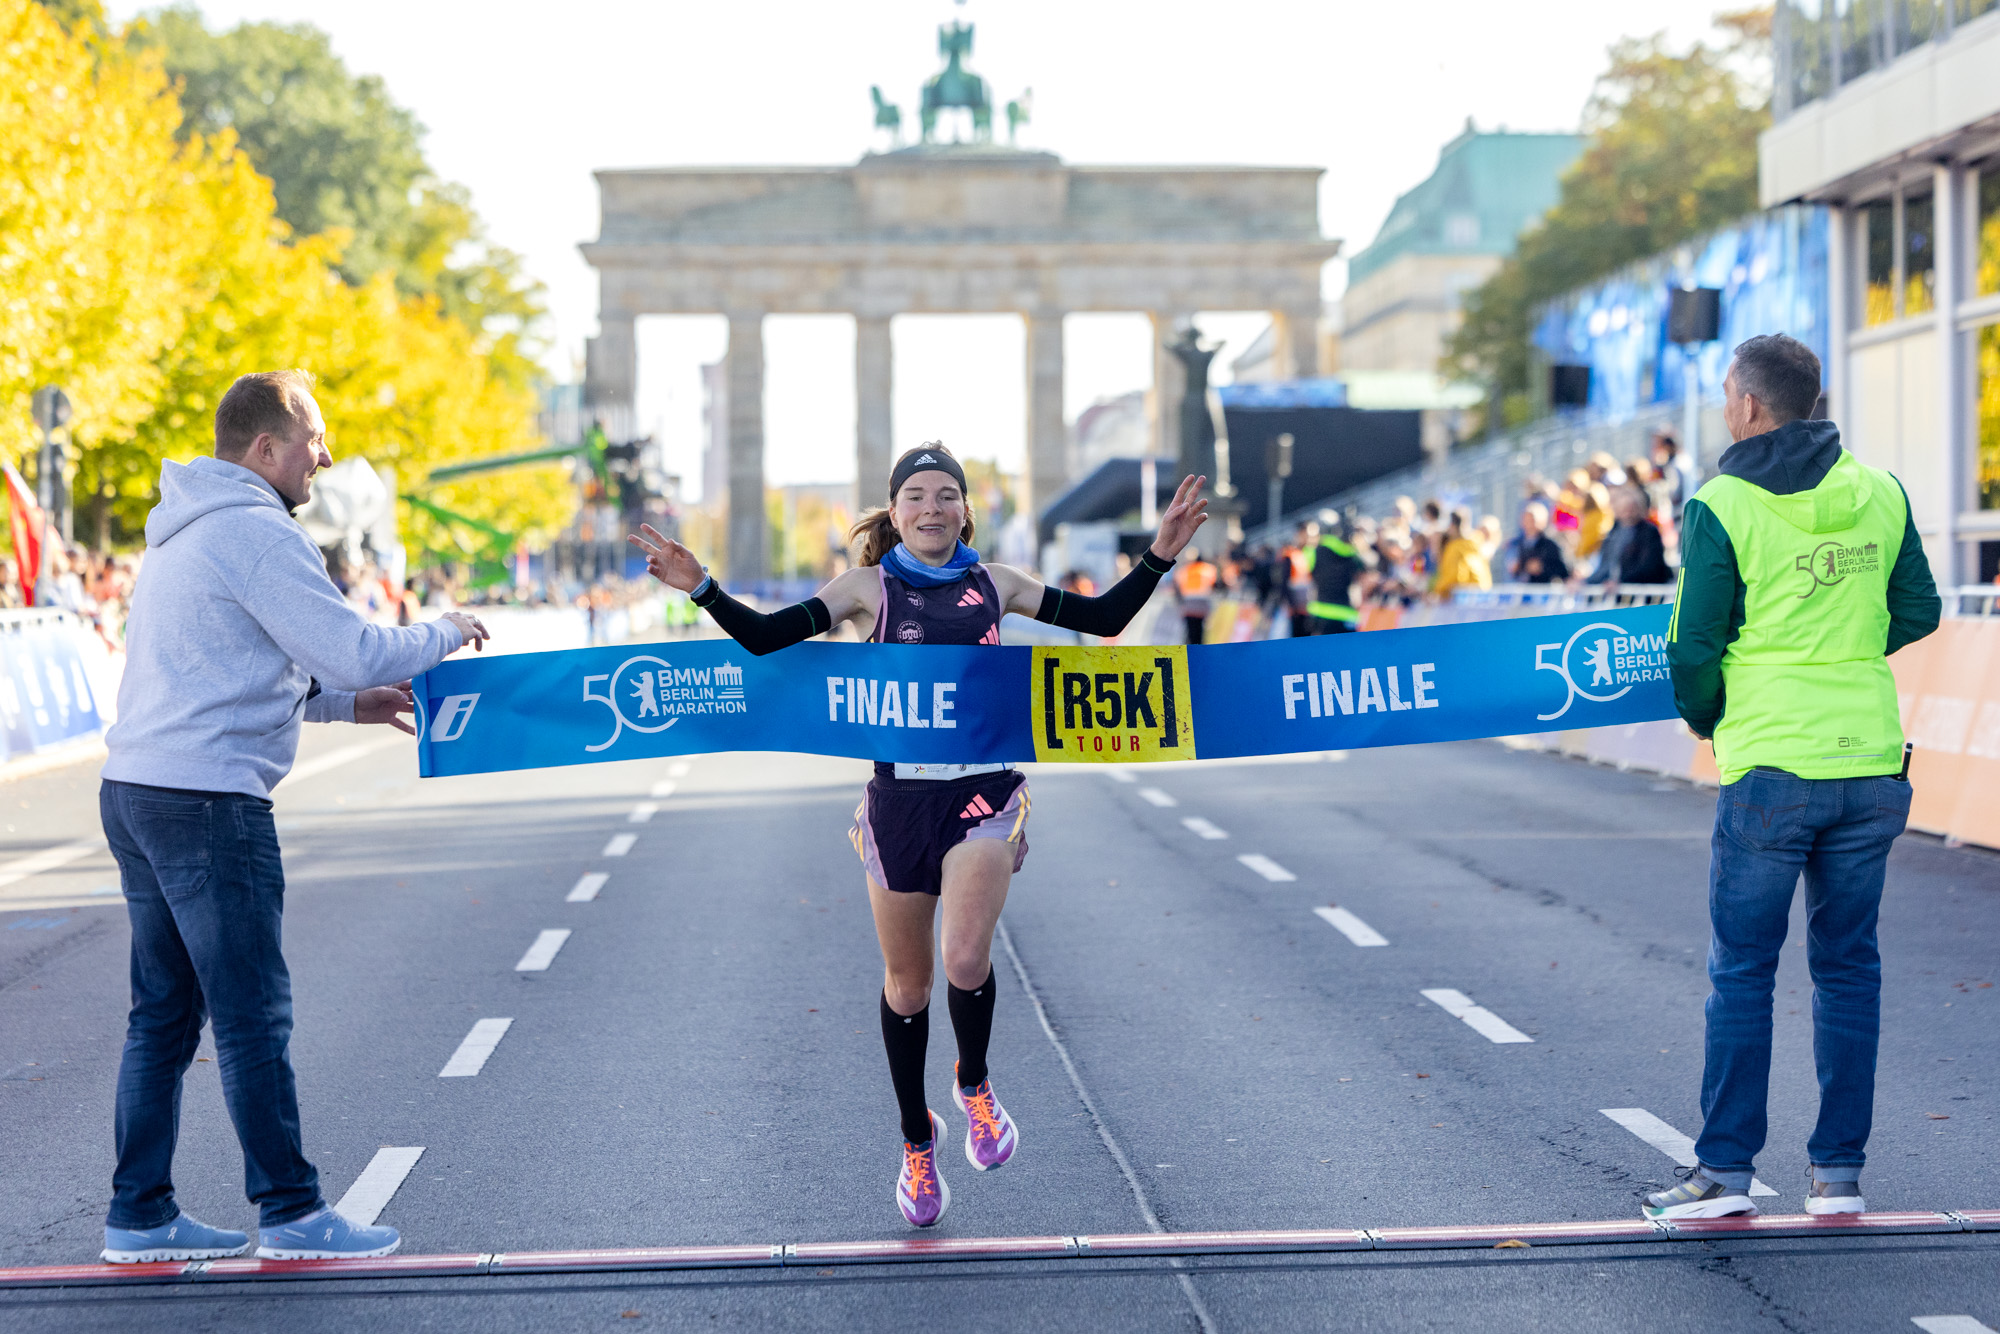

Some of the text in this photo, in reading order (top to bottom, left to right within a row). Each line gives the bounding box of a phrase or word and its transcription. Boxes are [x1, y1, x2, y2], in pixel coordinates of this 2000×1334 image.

[1836, 546, 1864, 560] BMW
[1837, 557, 1865, 568] BERLIN
[1796, 541, 1847, 600] 50
[1837, 564, 1879, 576] MARATHON
[1613, 633, 1668, 656] BMW
[657, 667, 711, 688] BMW
[1535, 622, 1634, 721] 50
[1616, 668, 1671, 685] MARAT
[660, 687, 715, 702] BERLIN
[1281, 662, 1440, 720] FINALE
[583, 655, 679, 752] 50
[662, 701, 748, 716] MARATHON
[826, 676, 957, 729] FINALE
[1076, 735, 1141, 752] TOUR
